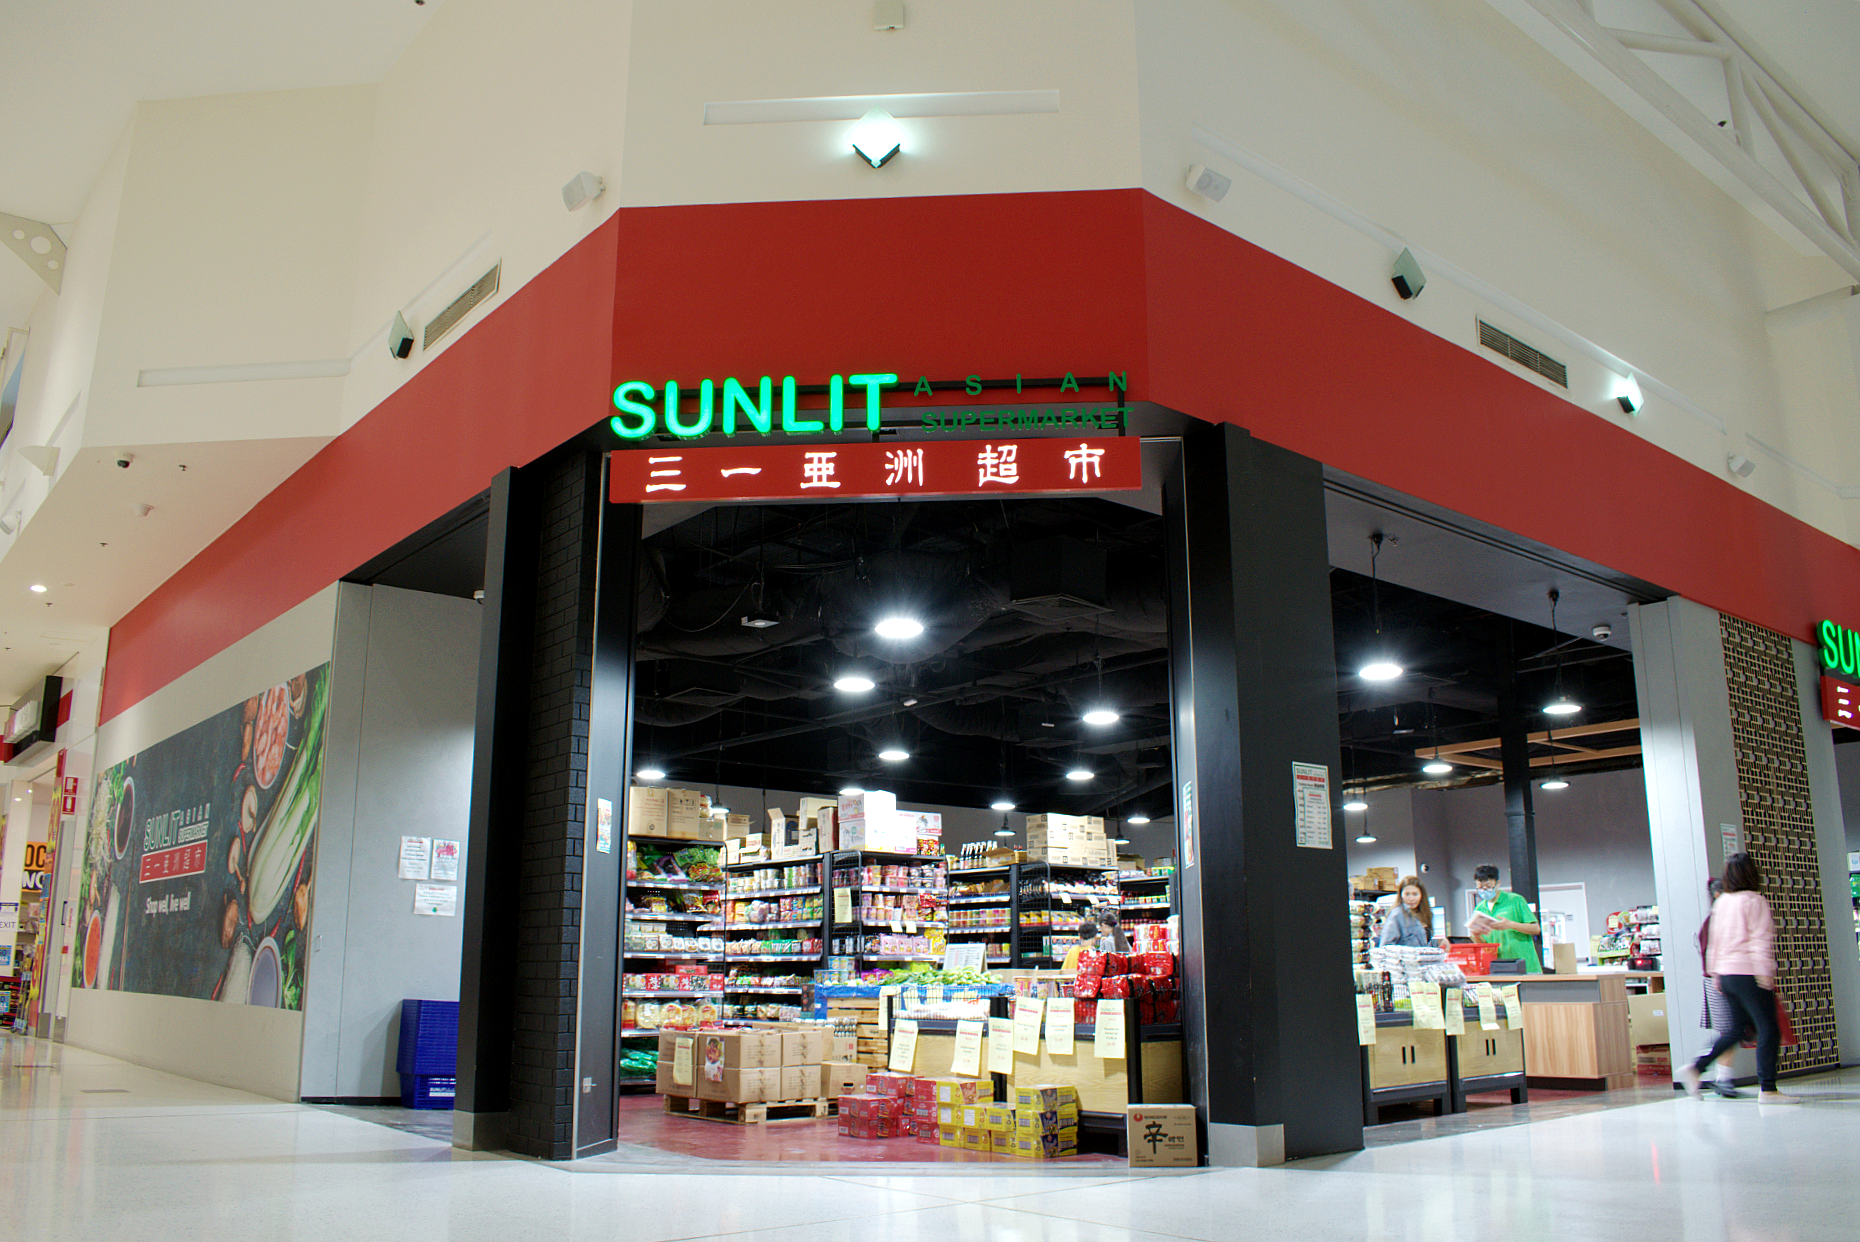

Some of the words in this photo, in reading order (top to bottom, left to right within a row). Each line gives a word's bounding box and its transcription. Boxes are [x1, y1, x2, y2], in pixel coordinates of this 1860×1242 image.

[610, 374, 898, 440] SUNLIT
[913, 371, 1128, 397] ASIAN
[920, 406, 1135, 434] SUPERMARKET
[143, 809, 181, 852] SUNLIT
[179, 802, 211, 827] ASIAN
[145, 896, 158, 918] Shop
[169, 893, 179, 912] live
[179, 891, 192, 911] well
[0, 921, 16, 929] EXIT
[1143, 1120, 1169, 1155] 辛
